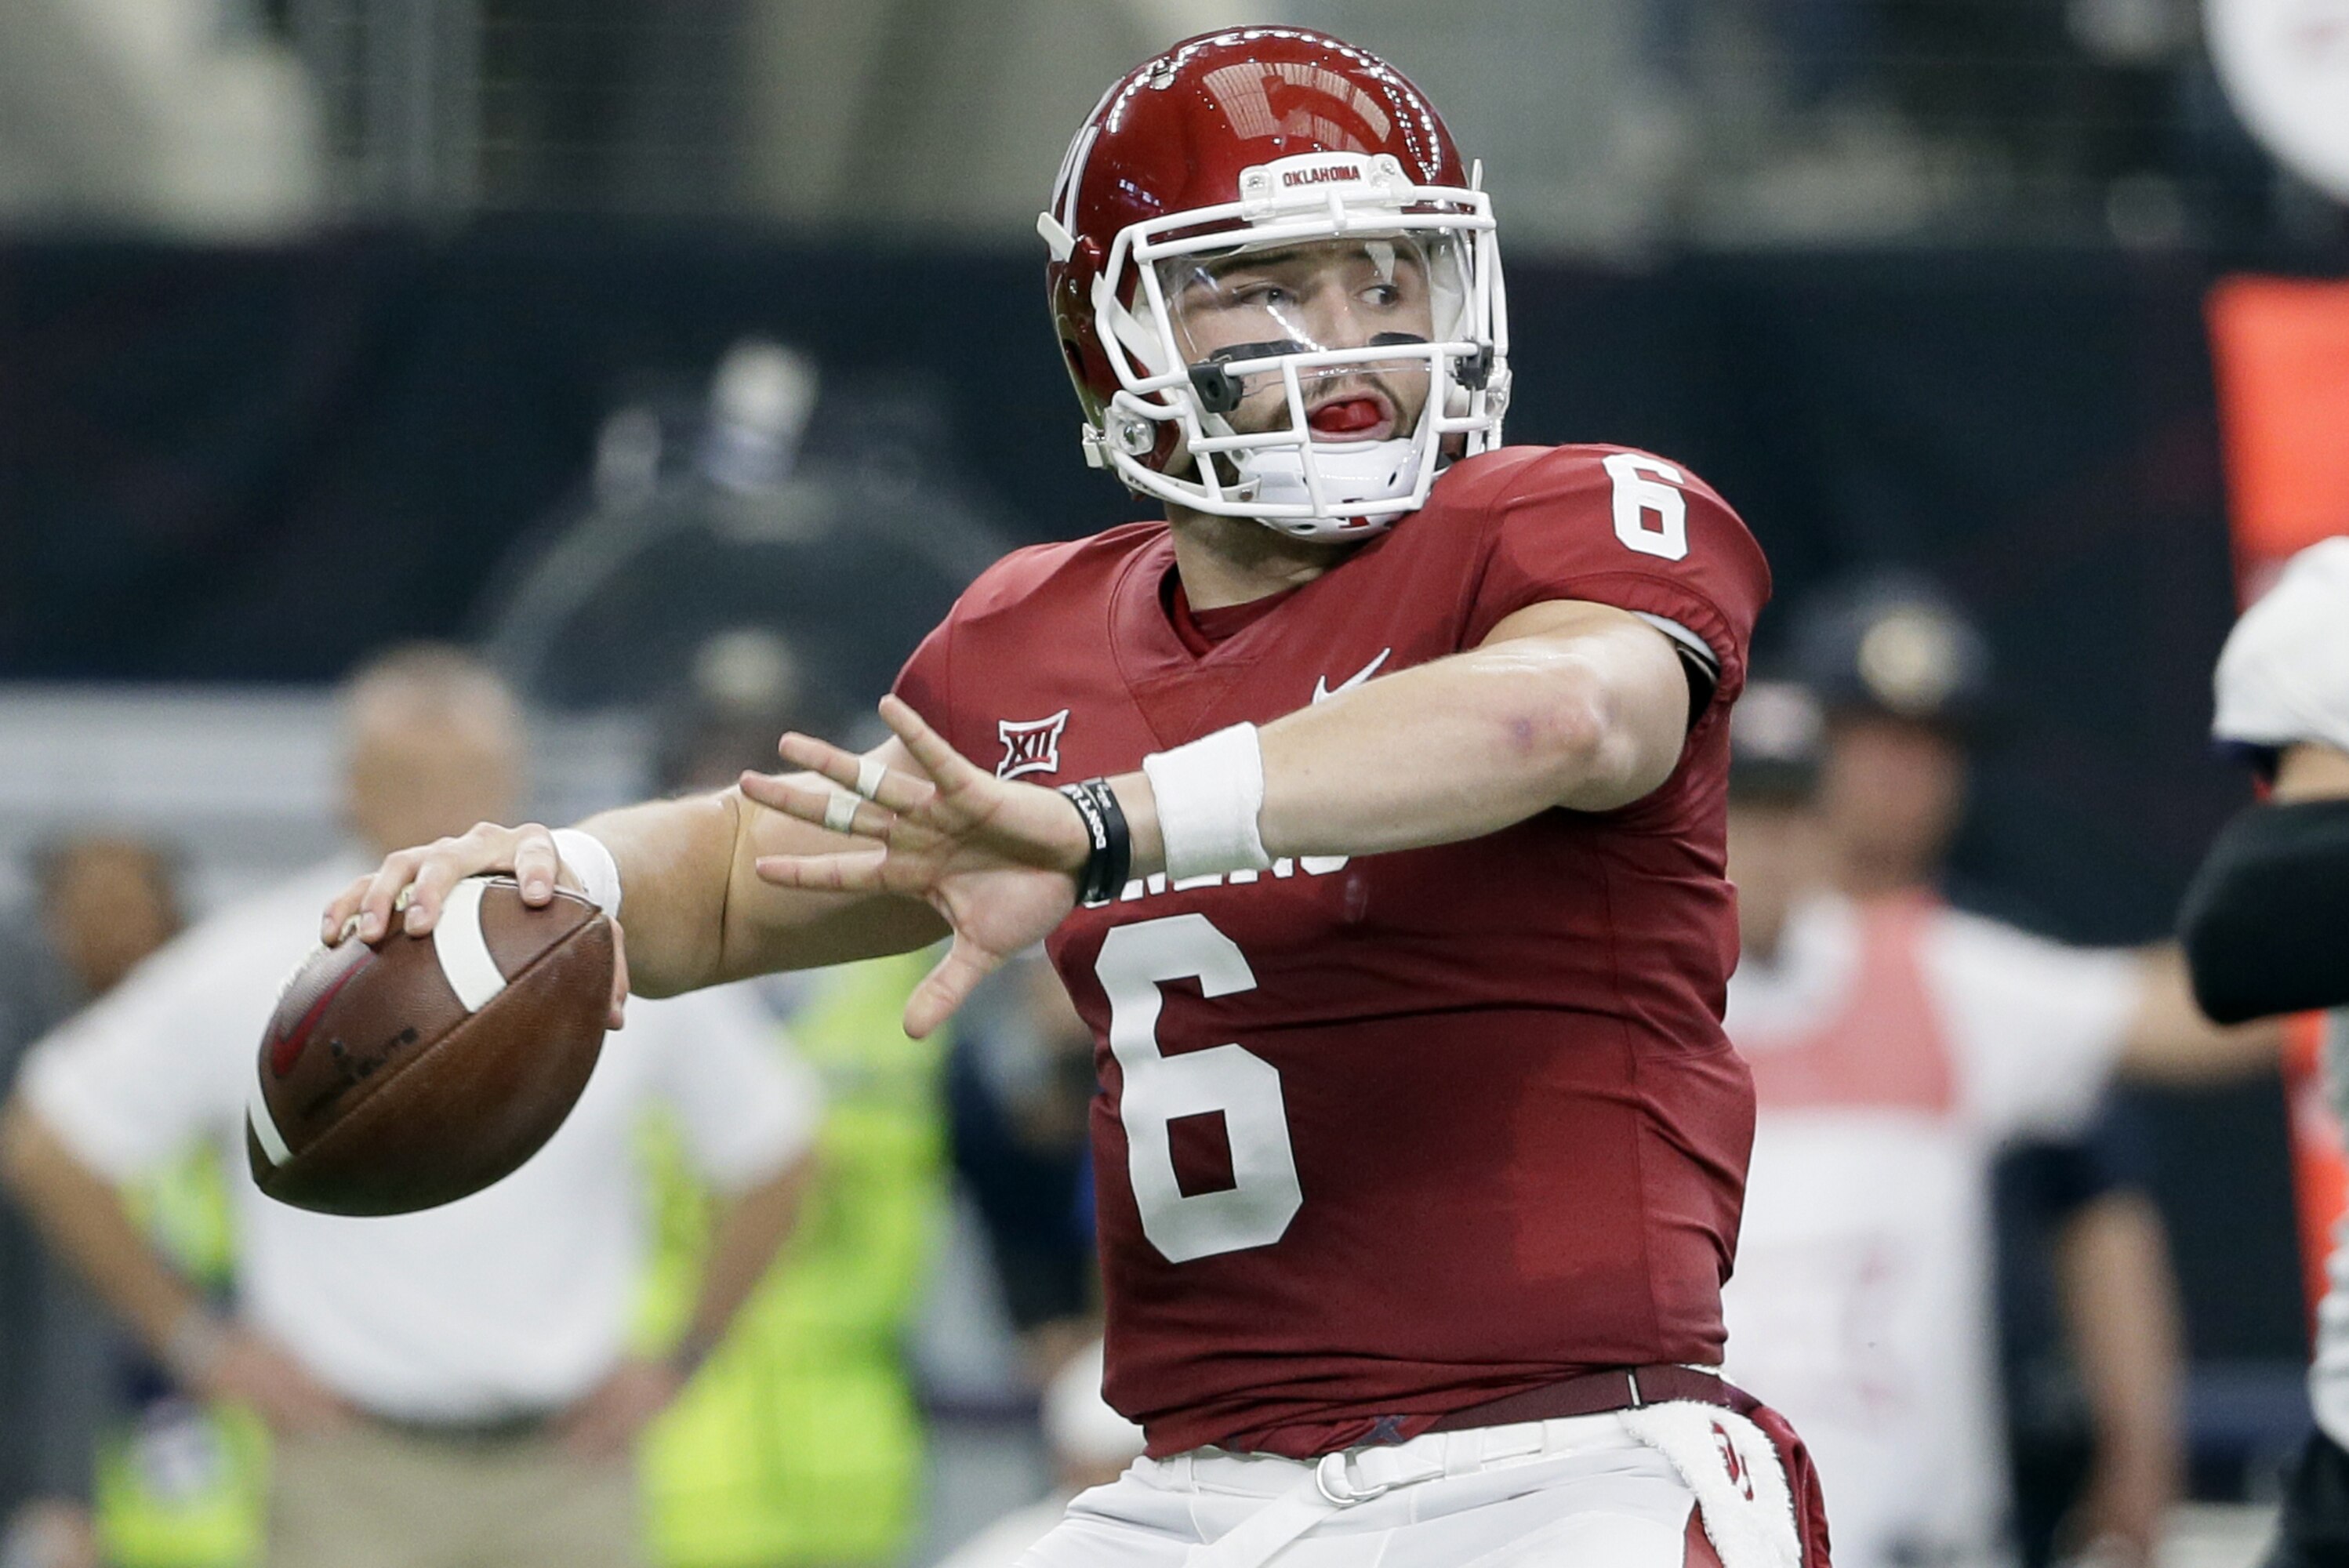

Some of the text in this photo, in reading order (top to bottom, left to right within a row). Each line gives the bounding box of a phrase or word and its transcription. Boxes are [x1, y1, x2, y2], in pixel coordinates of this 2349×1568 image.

[1283, 165, 1360, 187] OKLAHOMA
[1602, 453, 1688, 561] 6
[1095, 913, 1303, 1264] 6
